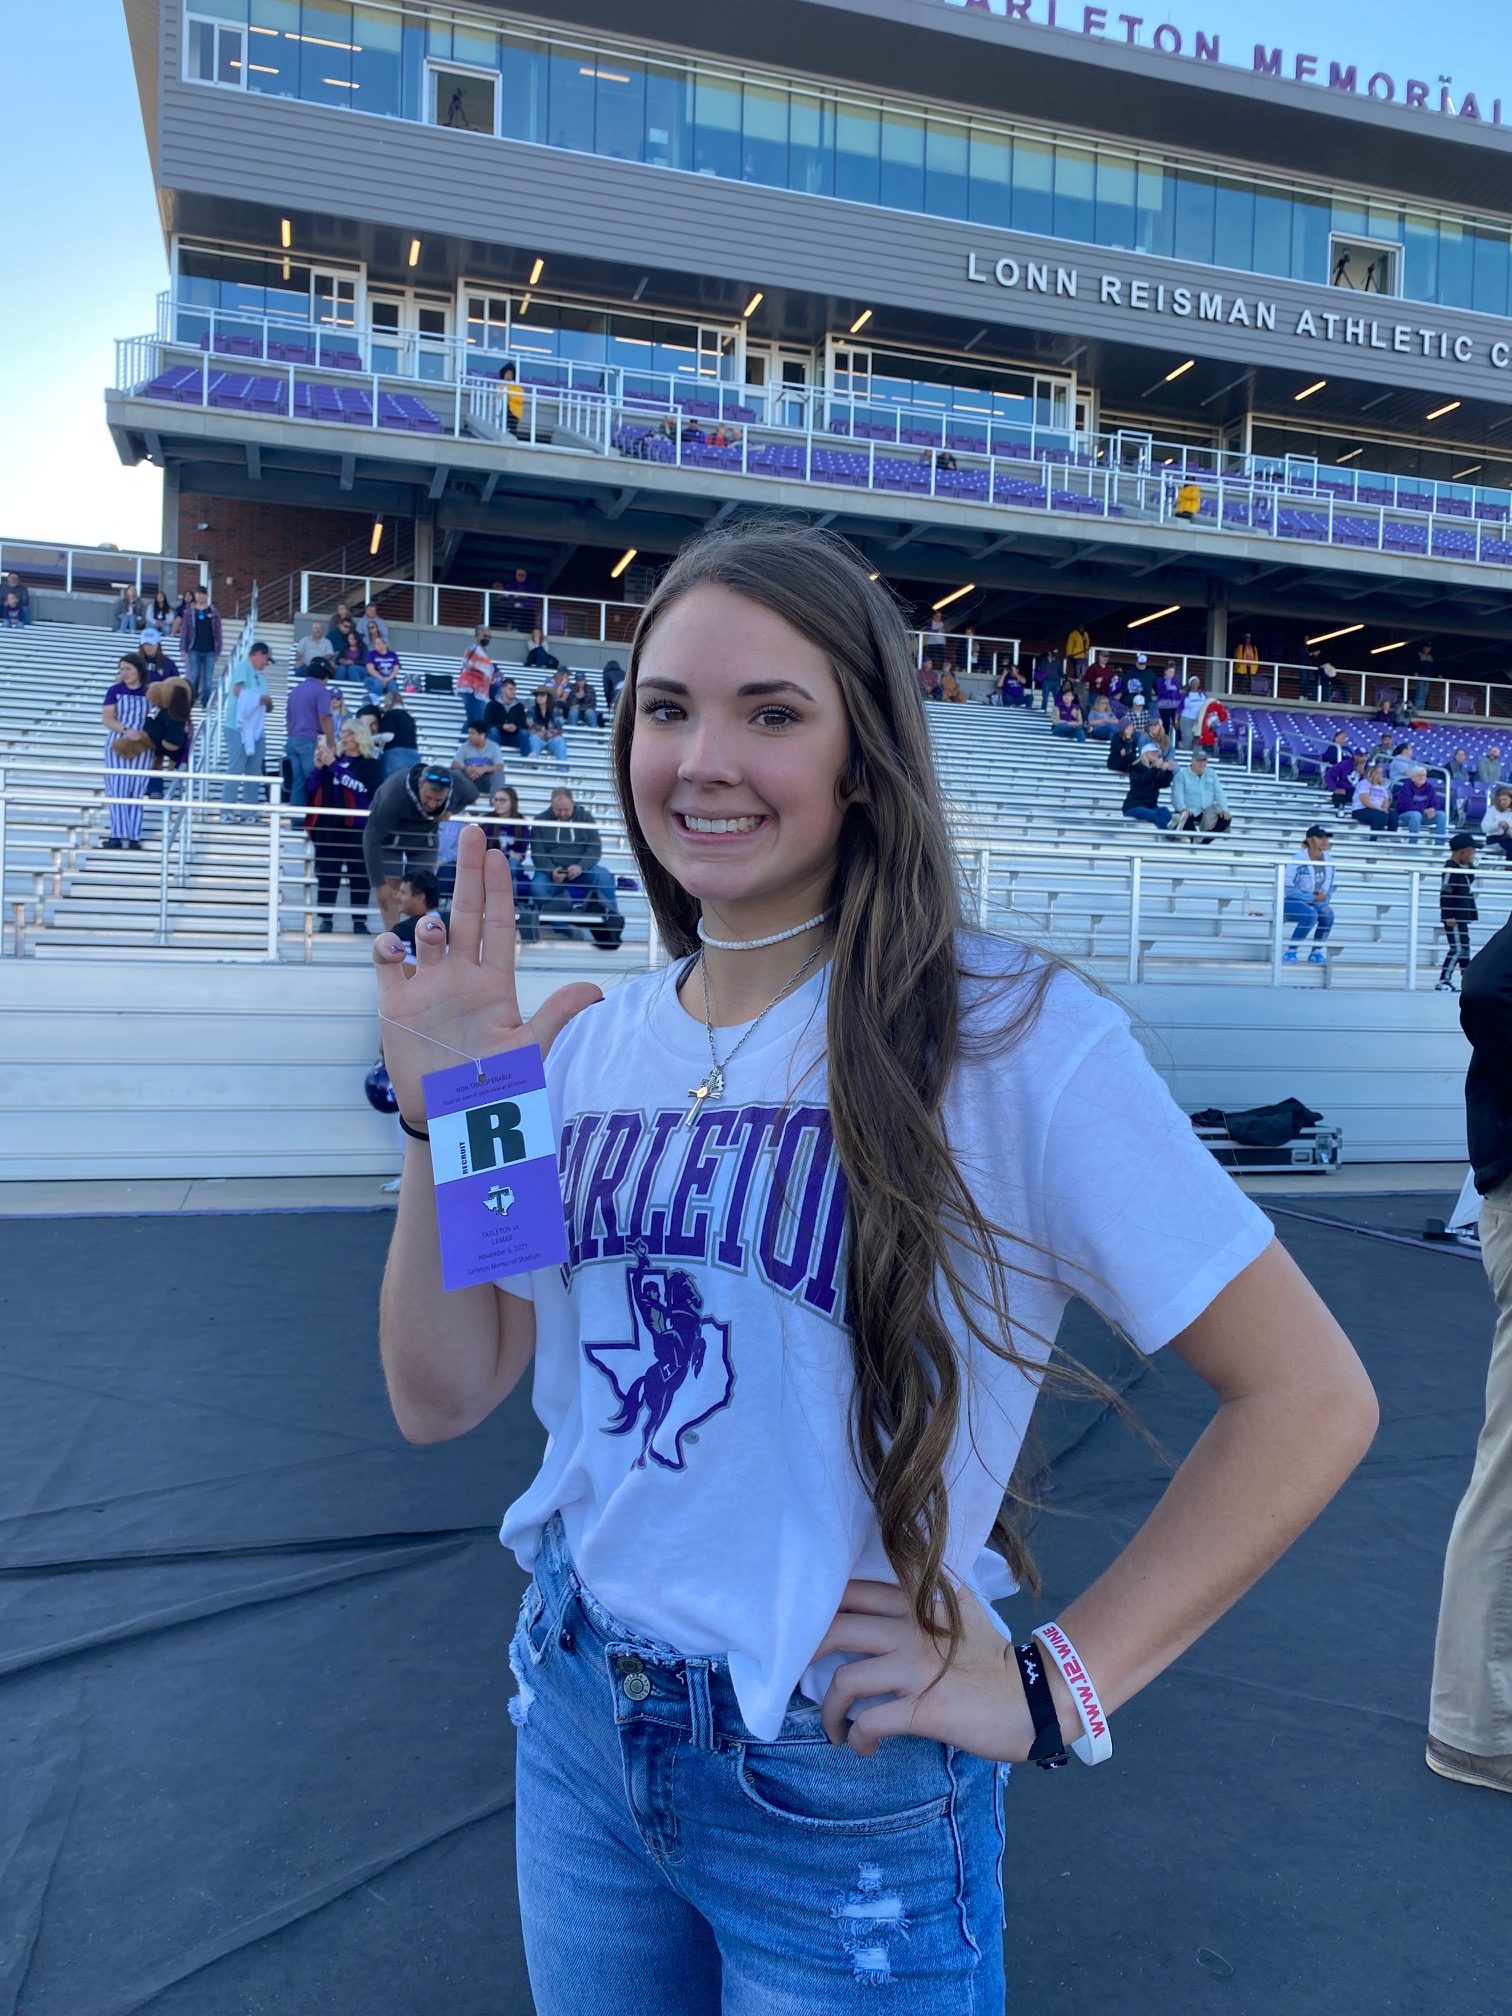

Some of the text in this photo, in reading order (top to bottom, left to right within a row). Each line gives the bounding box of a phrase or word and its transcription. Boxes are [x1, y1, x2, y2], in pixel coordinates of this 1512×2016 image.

[968, 251, 1078, 297] LONN
[1100, 274, 1276, 331] REISMAN
[1295, 308, 1473, 362] ATHLETIC
[459, 1141, 469, 1174] RECRUIT
[465, 1102, 526, 1172] R
[482, 1227, 511, 1238] TARLETON
